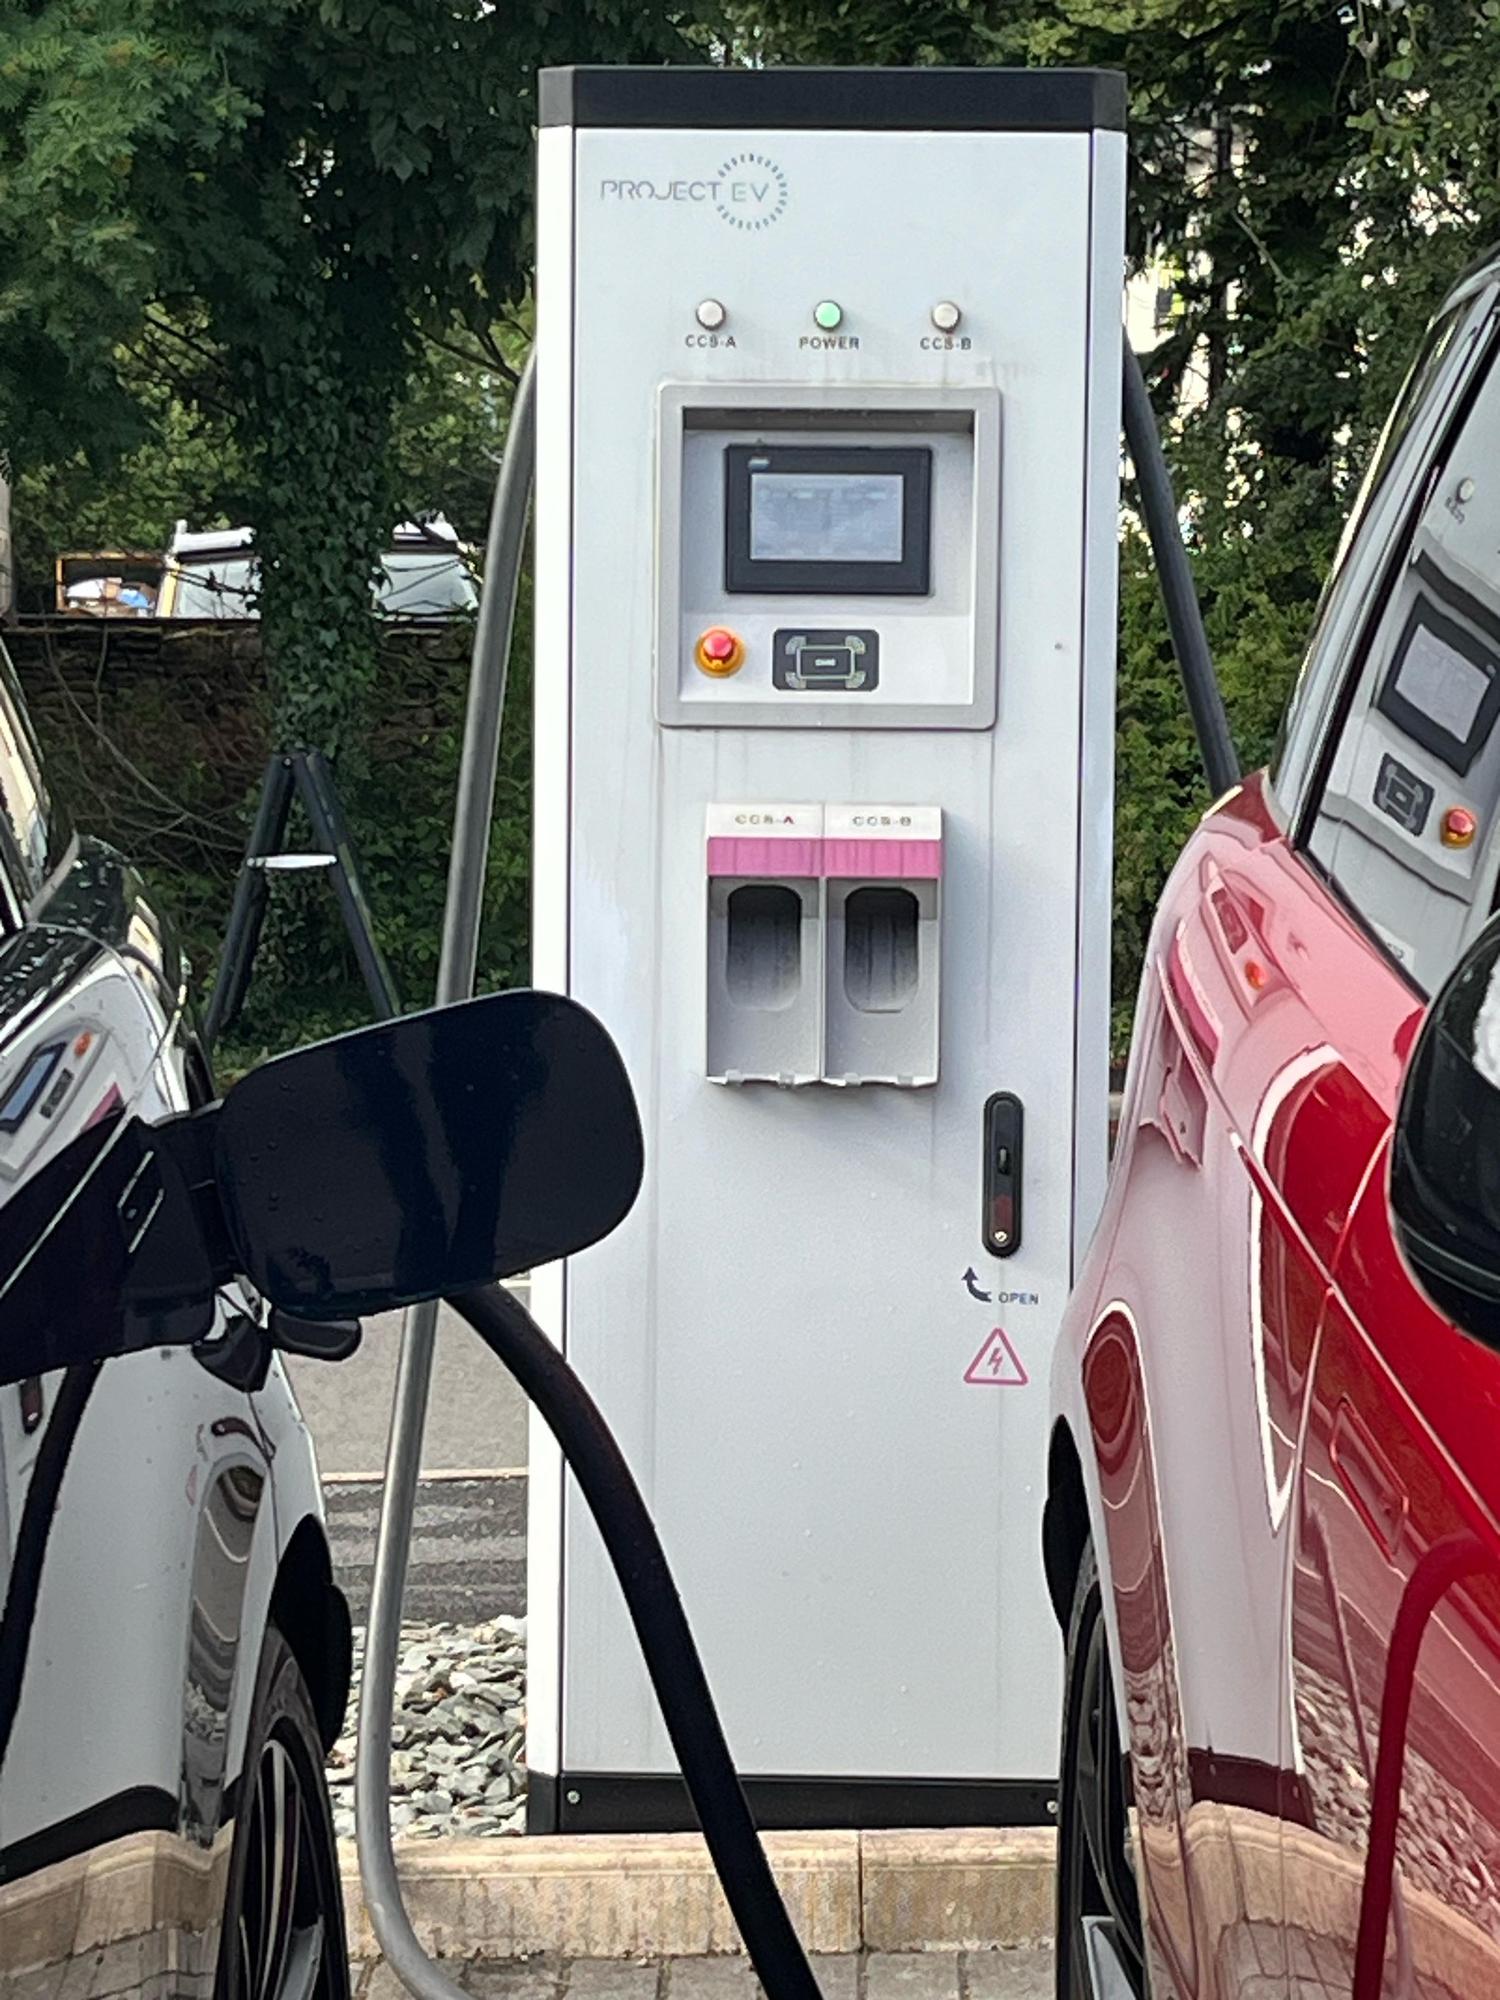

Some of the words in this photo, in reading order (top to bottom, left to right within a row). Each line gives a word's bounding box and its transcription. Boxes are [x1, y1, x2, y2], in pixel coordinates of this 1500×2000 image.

[601, 180, 721, 201] PROJECT
[731, 182, 769, 202] EV
[685, 334, 736, 348] CCS-A
[799, 337, 860, 350] POWER
[920, 337, 972, 350] CCS-B
[998, 1291, 1039, 1305] OPEN
